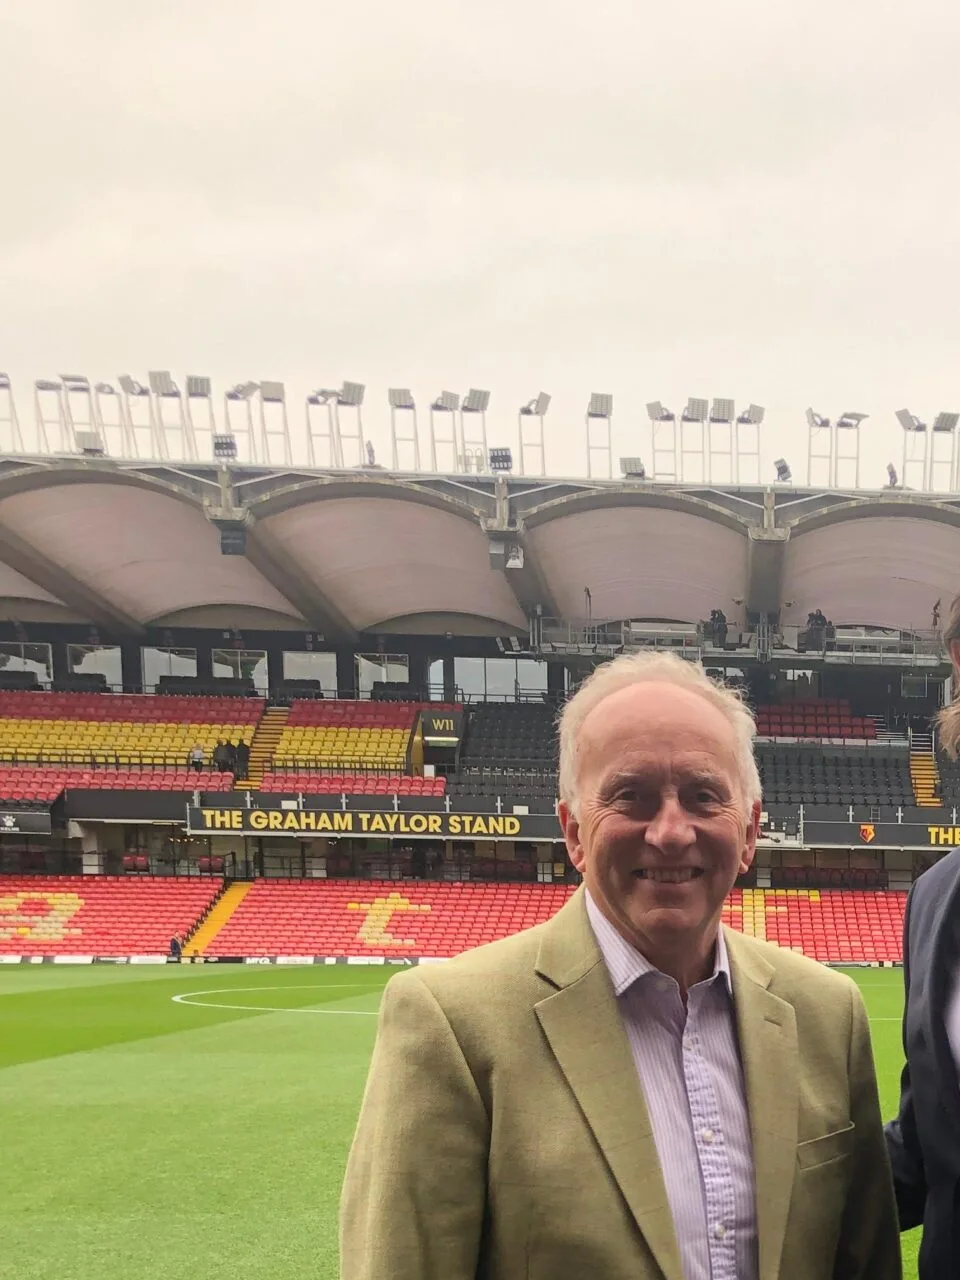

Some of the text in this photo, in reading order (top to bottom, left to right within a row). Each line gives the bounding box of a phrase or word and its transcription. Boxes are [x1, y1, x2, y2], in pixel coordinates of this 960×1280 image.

[432, 718, 454, 731] W11
[202, 809, 521, 835] THE GRAHAM TAYLOR STAND
